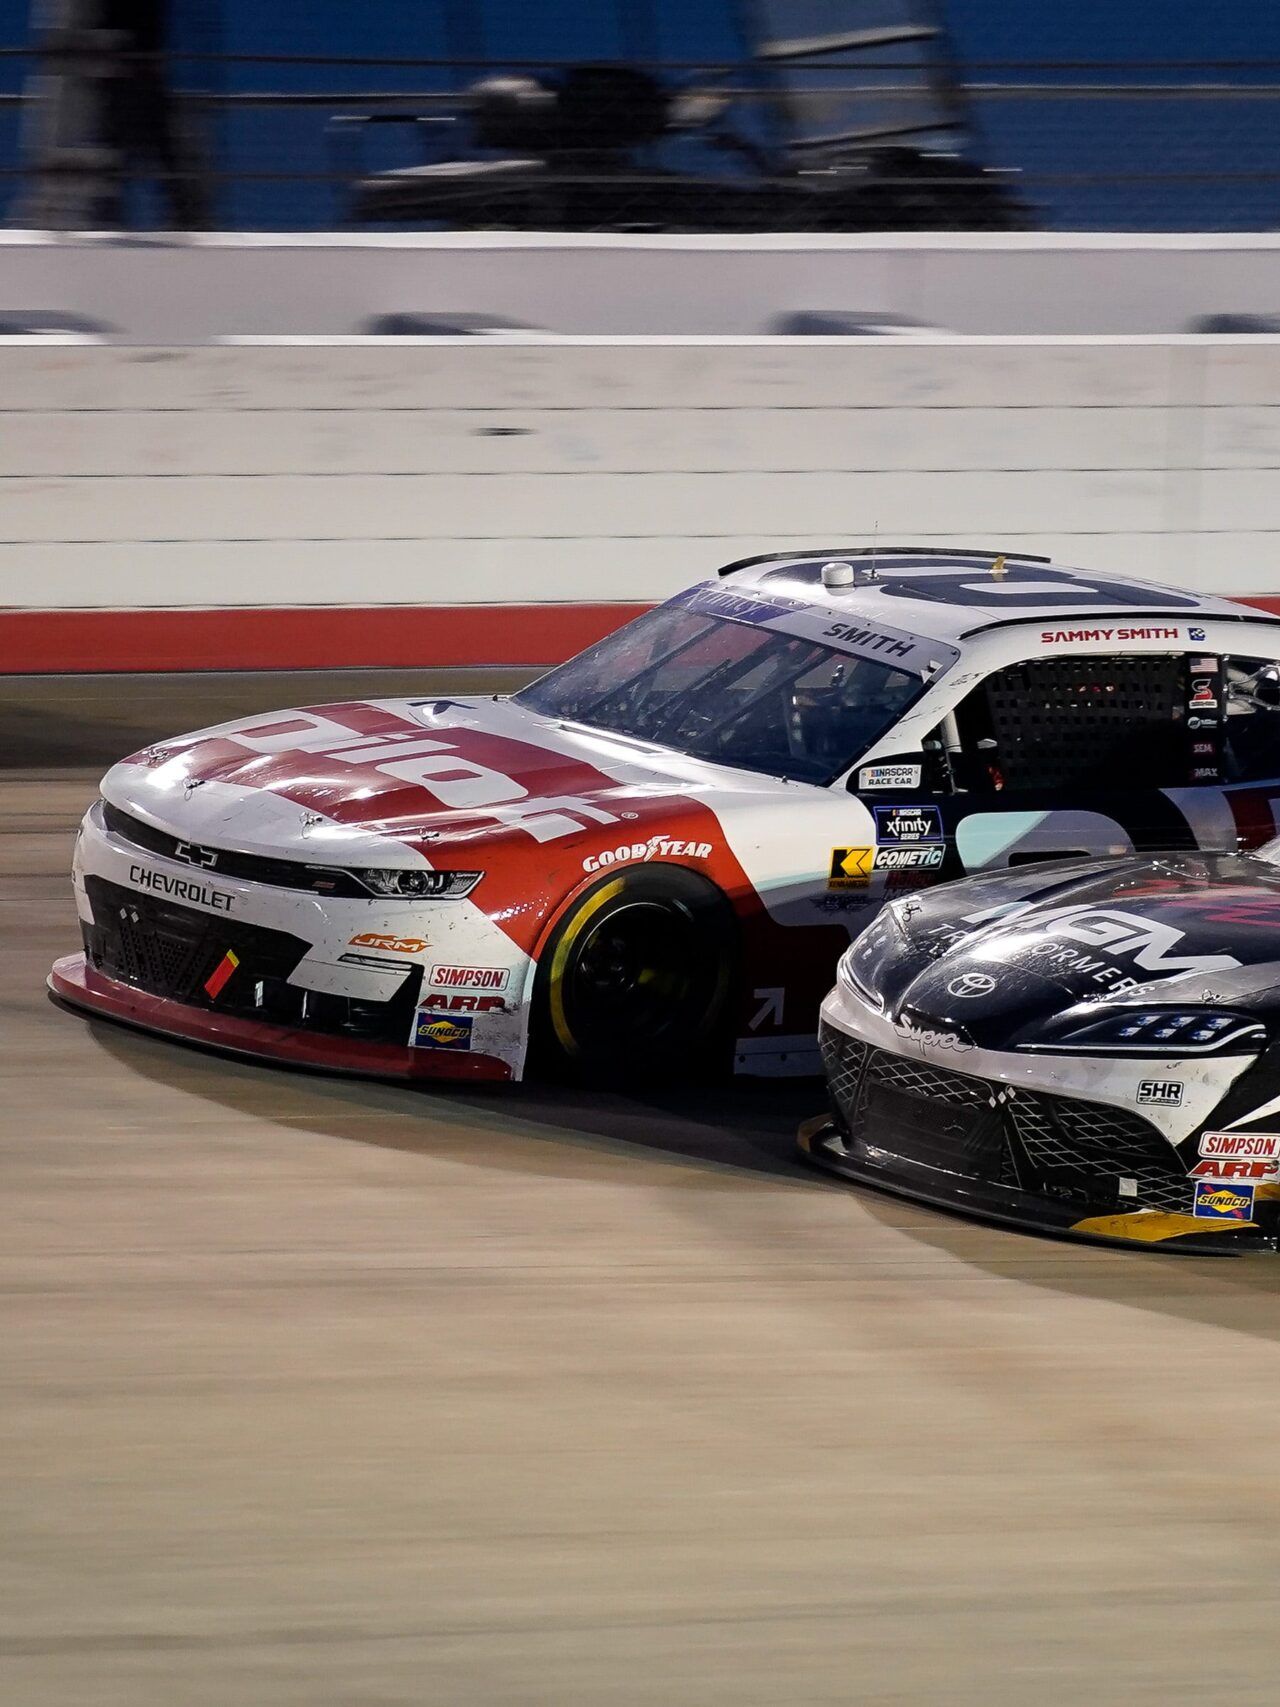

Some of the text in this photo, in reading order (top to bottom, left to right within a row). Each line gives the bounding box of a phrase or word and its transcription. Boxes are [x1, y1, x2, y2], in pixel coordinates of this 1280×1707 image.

[822, 622, 916, 658] SMITH
[1041, 627, 1179, 643] SAMMY SMITH
[868, 777, 913, 787] RACE CAR
[880, 767, 914, 778] NASCAR
[886, 817, 932, 837] xfinity
[875, 847, 942, 866] COMETIC
[129, 866, 236, 912] CHEVROLET
[355, 937, 420, 952] JRM
[927, 923, 1156, 998] TRORMERS
[434, 967, 504, 988] SIMPSON
[418, 993, 506, 1012] ARP
[418, 1024, 469, 1039] SUNOCO
[894, 1012, 977, 1058] Supra
[1139, 1082, 1181, 1099] SHR
[1206, 1136, 1277, 1155] SIMPSON
[1189, 1161, 1280, 1178] ARP
[1199, 1195, 1250, 1207] SUNOCO
